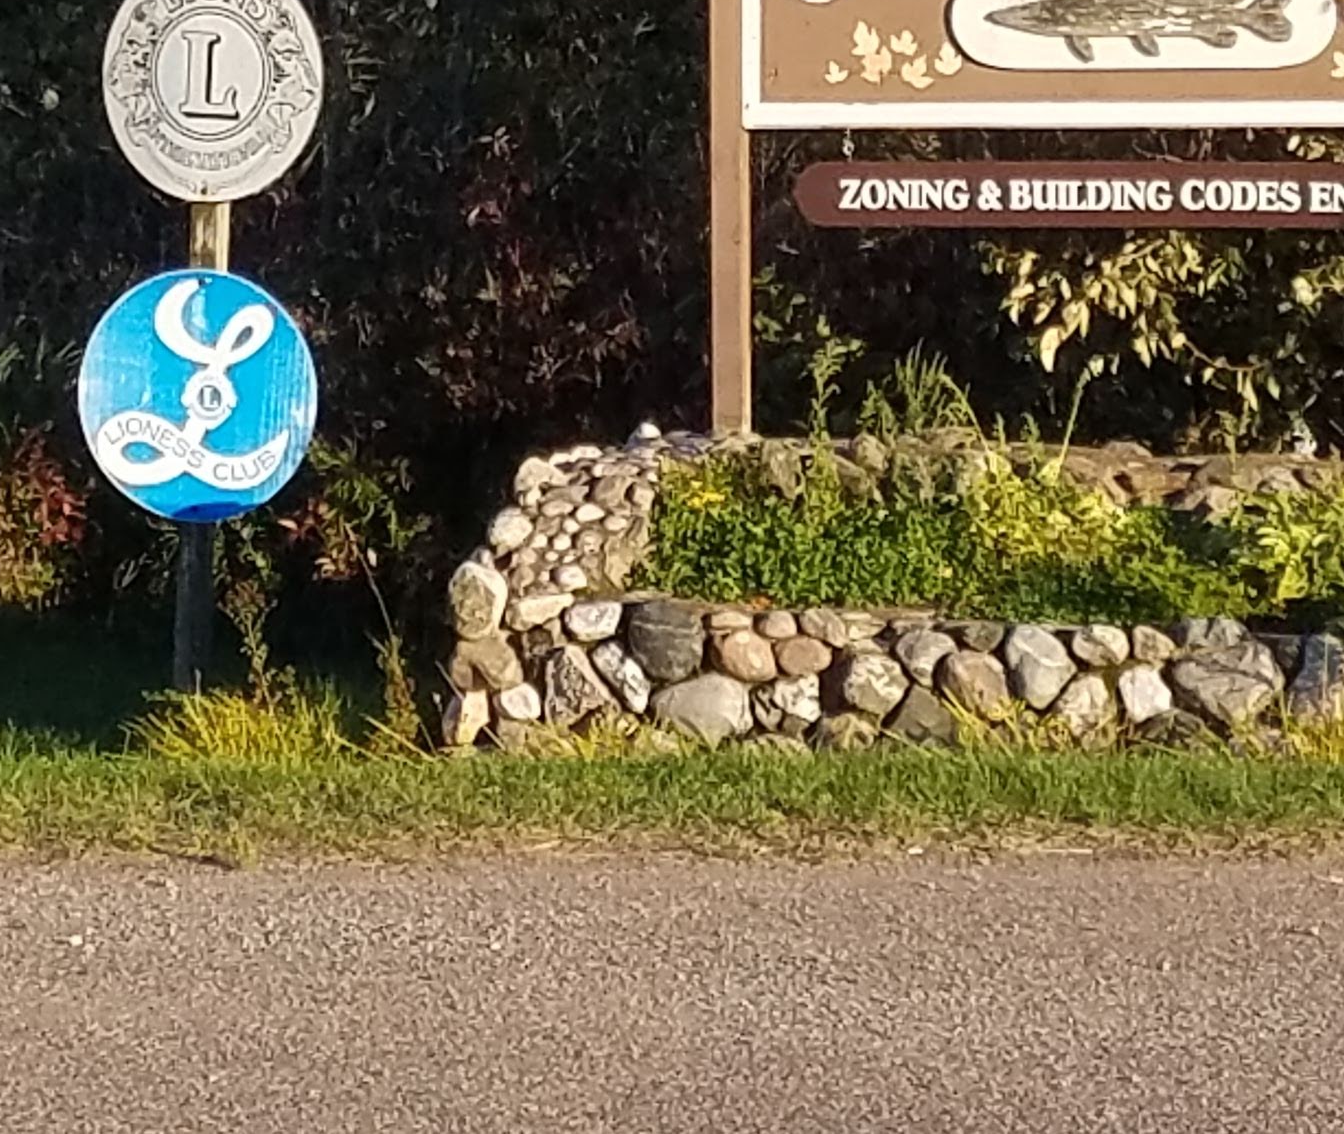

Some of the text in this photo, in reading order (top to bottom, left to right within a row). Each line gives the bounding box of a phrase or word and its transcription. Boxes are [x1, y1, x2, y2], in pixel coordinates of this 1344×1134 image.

[178, 30, 240, 121] L
[838, 178, 970, 212] ZONING
[977, 179, 1004, 212] &
[1008, 179, 1174, 213] BUILDING
[1180, 181, 1302, 214] CODES
[103, 416, 276, 482] LIONESS CLUB
